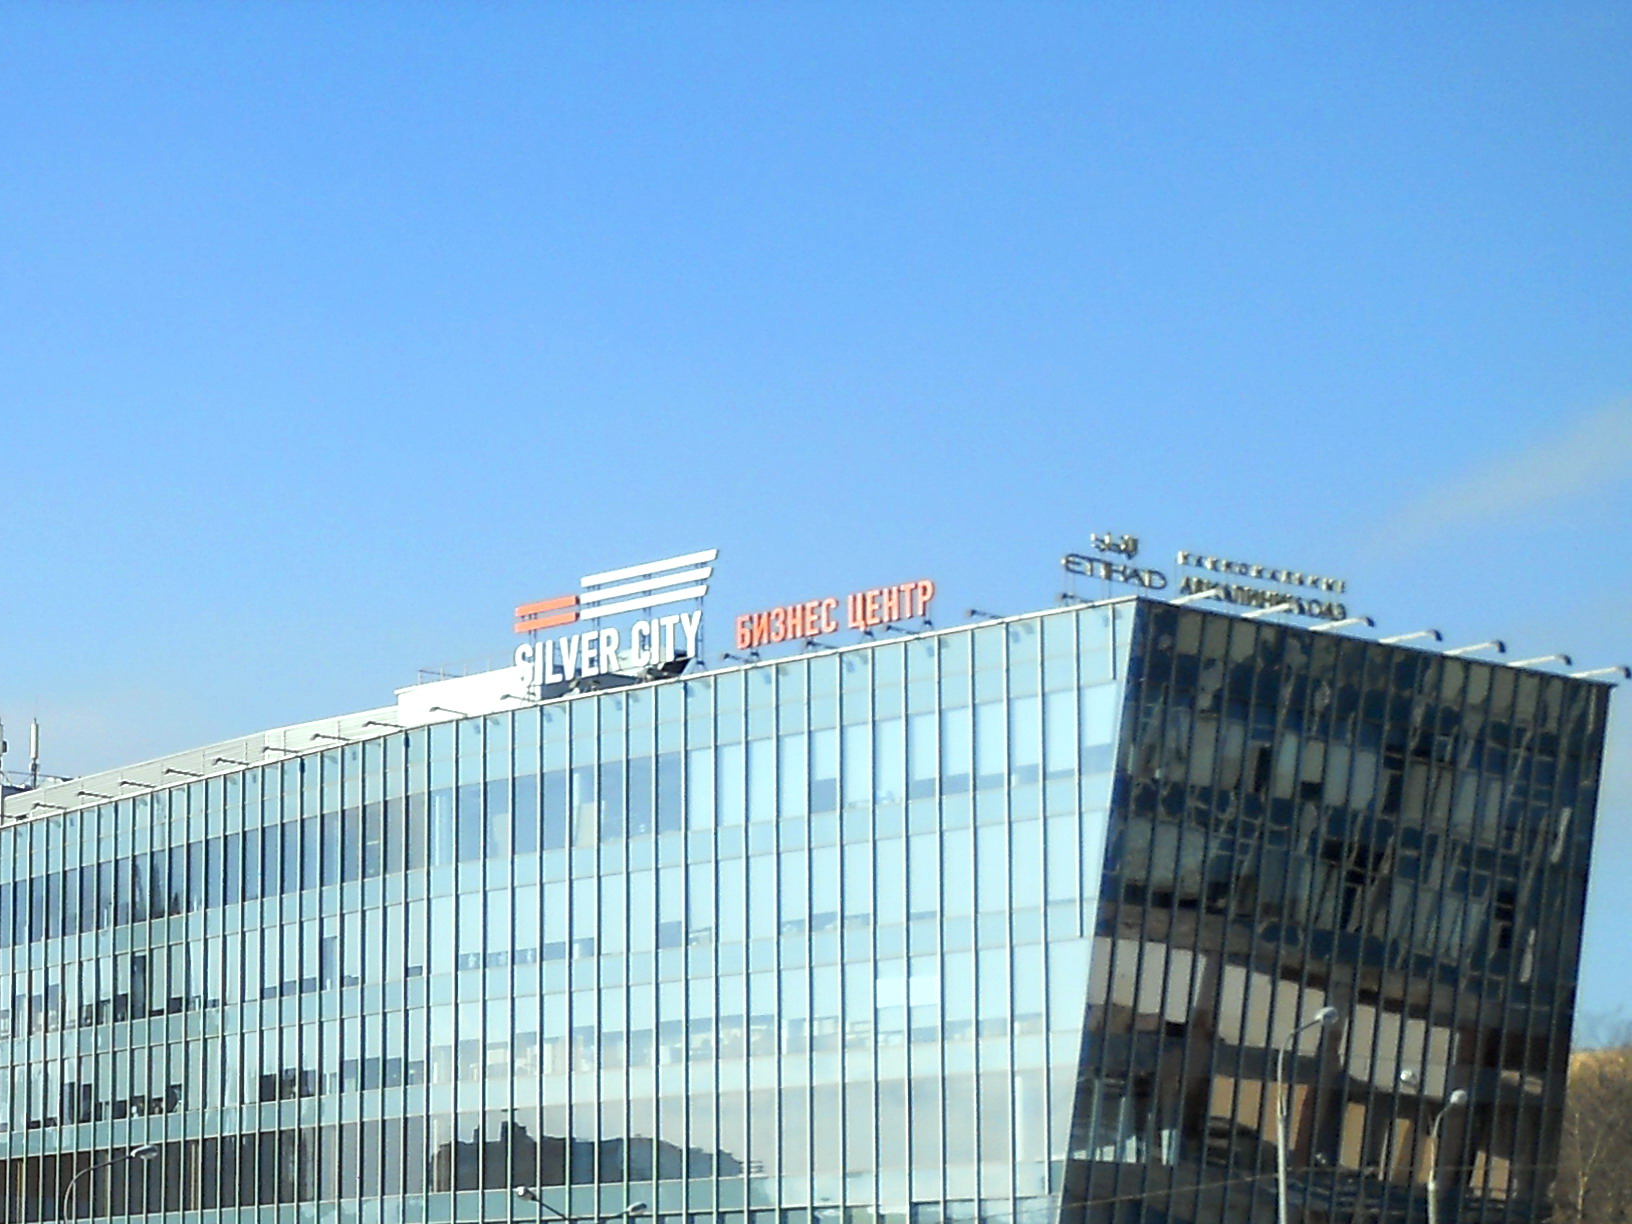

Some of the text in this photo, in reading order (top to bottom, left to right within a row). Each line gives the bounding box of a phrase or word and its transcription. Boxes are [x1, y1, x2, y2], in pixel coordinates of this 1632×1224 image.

[1061, 553, 1167, 589] ETIHAD
[515, 610, 703, 688] SILVER CITY
[736, 579, 935, 650] БИЗНЕС ЦЕНТР
